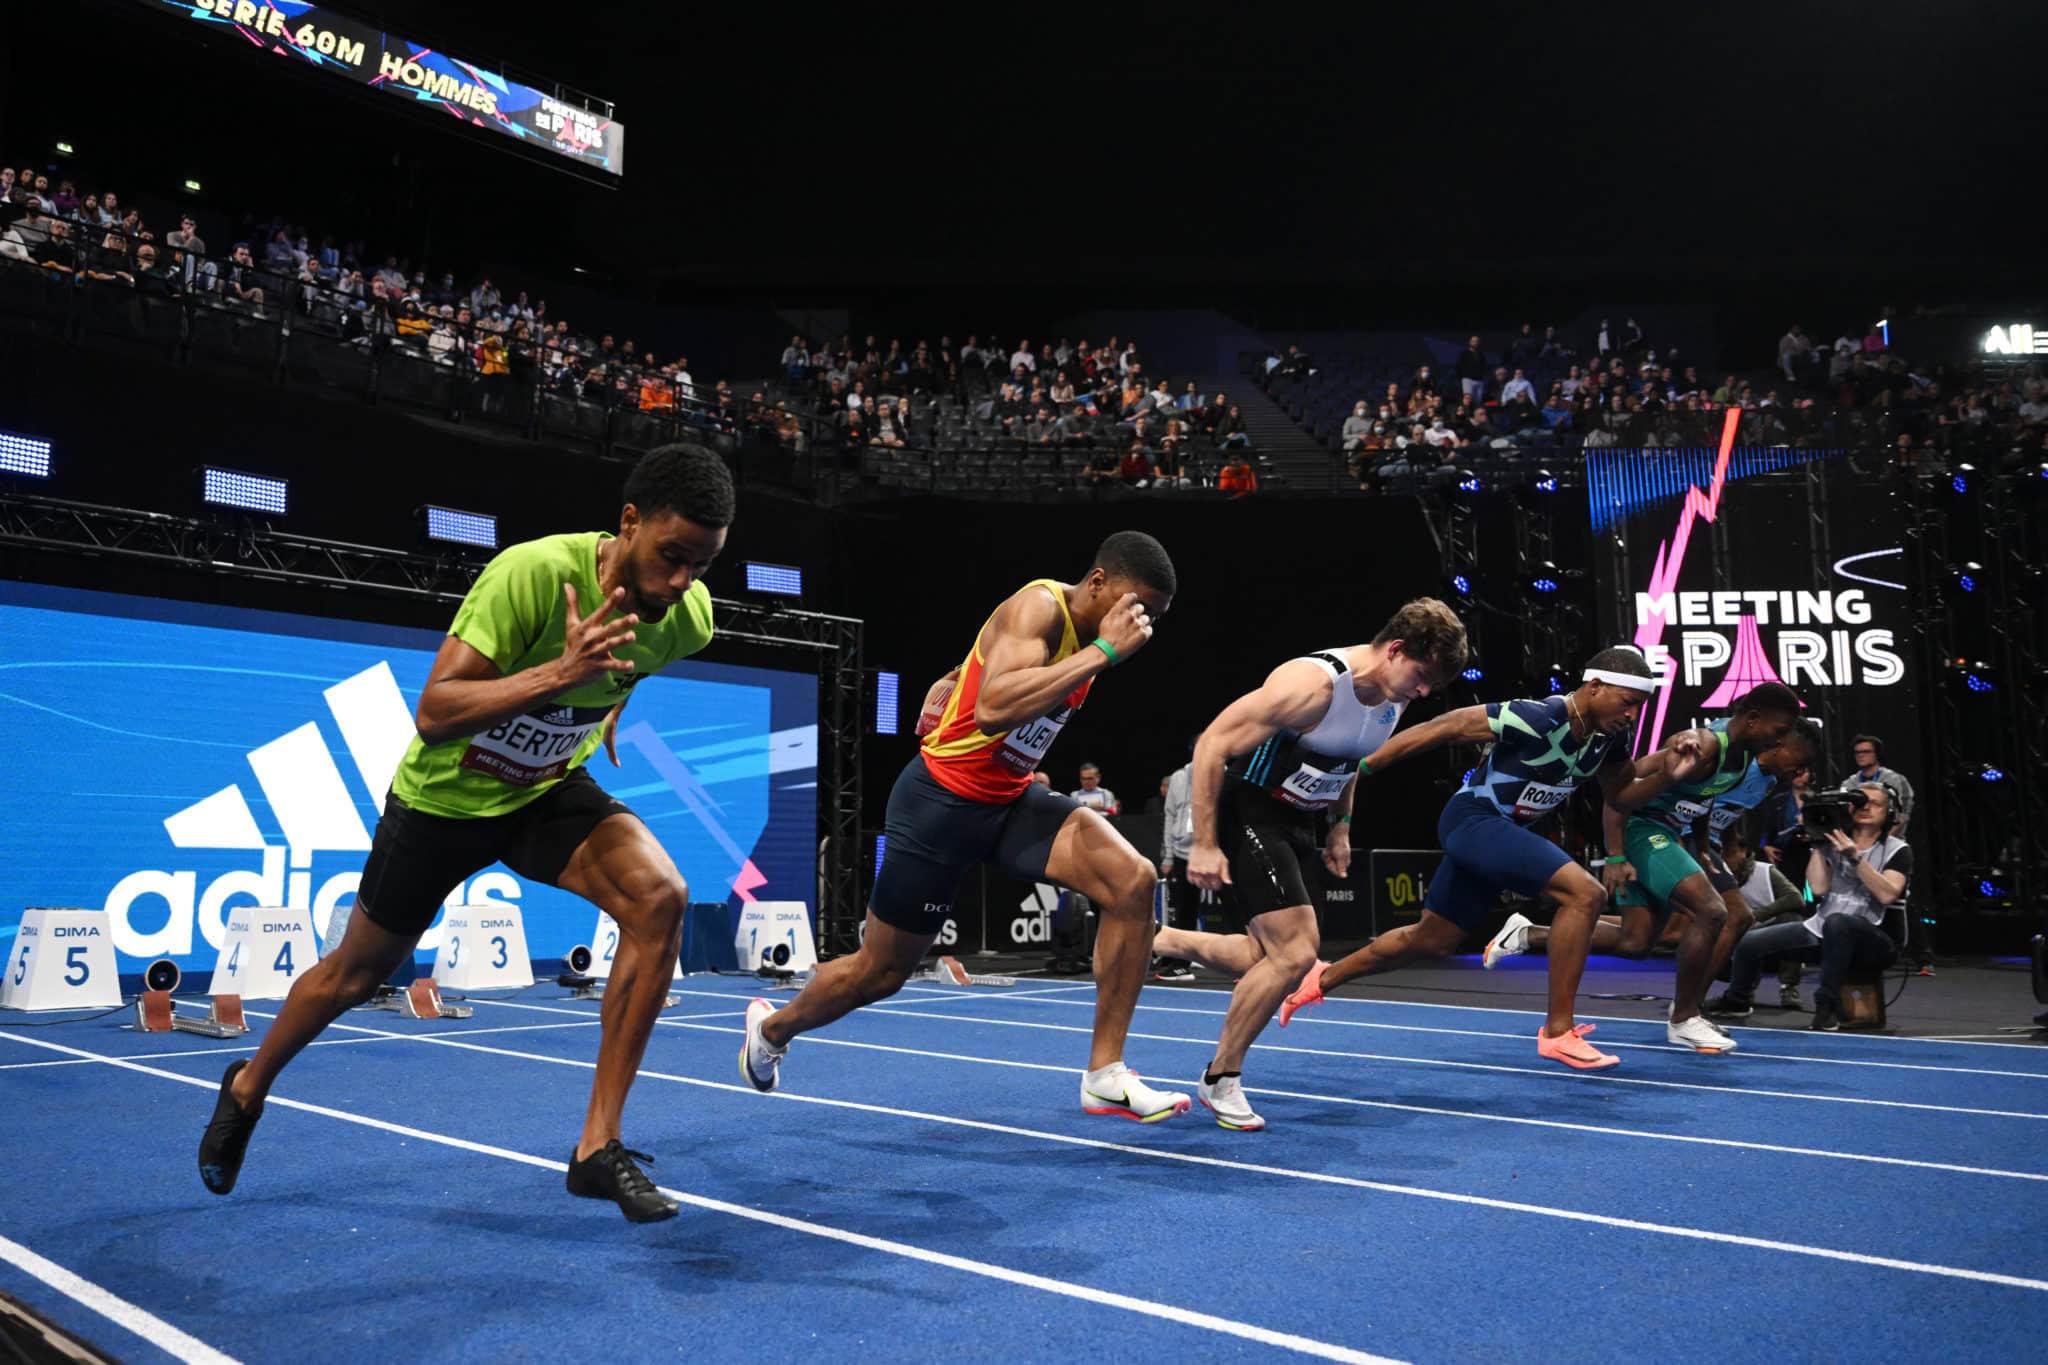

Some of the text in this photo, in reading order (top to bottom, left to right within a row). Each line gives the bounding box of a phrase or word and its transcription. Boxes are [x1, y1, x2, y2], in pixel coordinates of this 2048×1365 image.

[295, 24, 366, 66] 60M
[379, 52, 499, 115] HOMMES
[1634, 589, 1872, 625] MEETING
[1613, 645, 1670, 687] E
[103, 845, 523, 958] adis
[1326, 890, 1354, 902] PARIS
[54, 927, 101, 937] DIMA
[263, 922, 303, 933] DIMA
[481, 919, 514, 928] DIMA
[776, 913, 802, 921] DIMA
[1011, 910, 1051, 944] adi
[447, 936, 461, 969] 3
[490, 936, 508, 969] 3
[603, 931, 617, 961] 2
[750, 927, 758, 955] 1
[786, 927, 796, 955] 1
[15, 946, 31, 986] 5
[64, 946, 90, 987] 5
[227, 941, 241, 977] 4
[273, 941, 295, 977] 4
